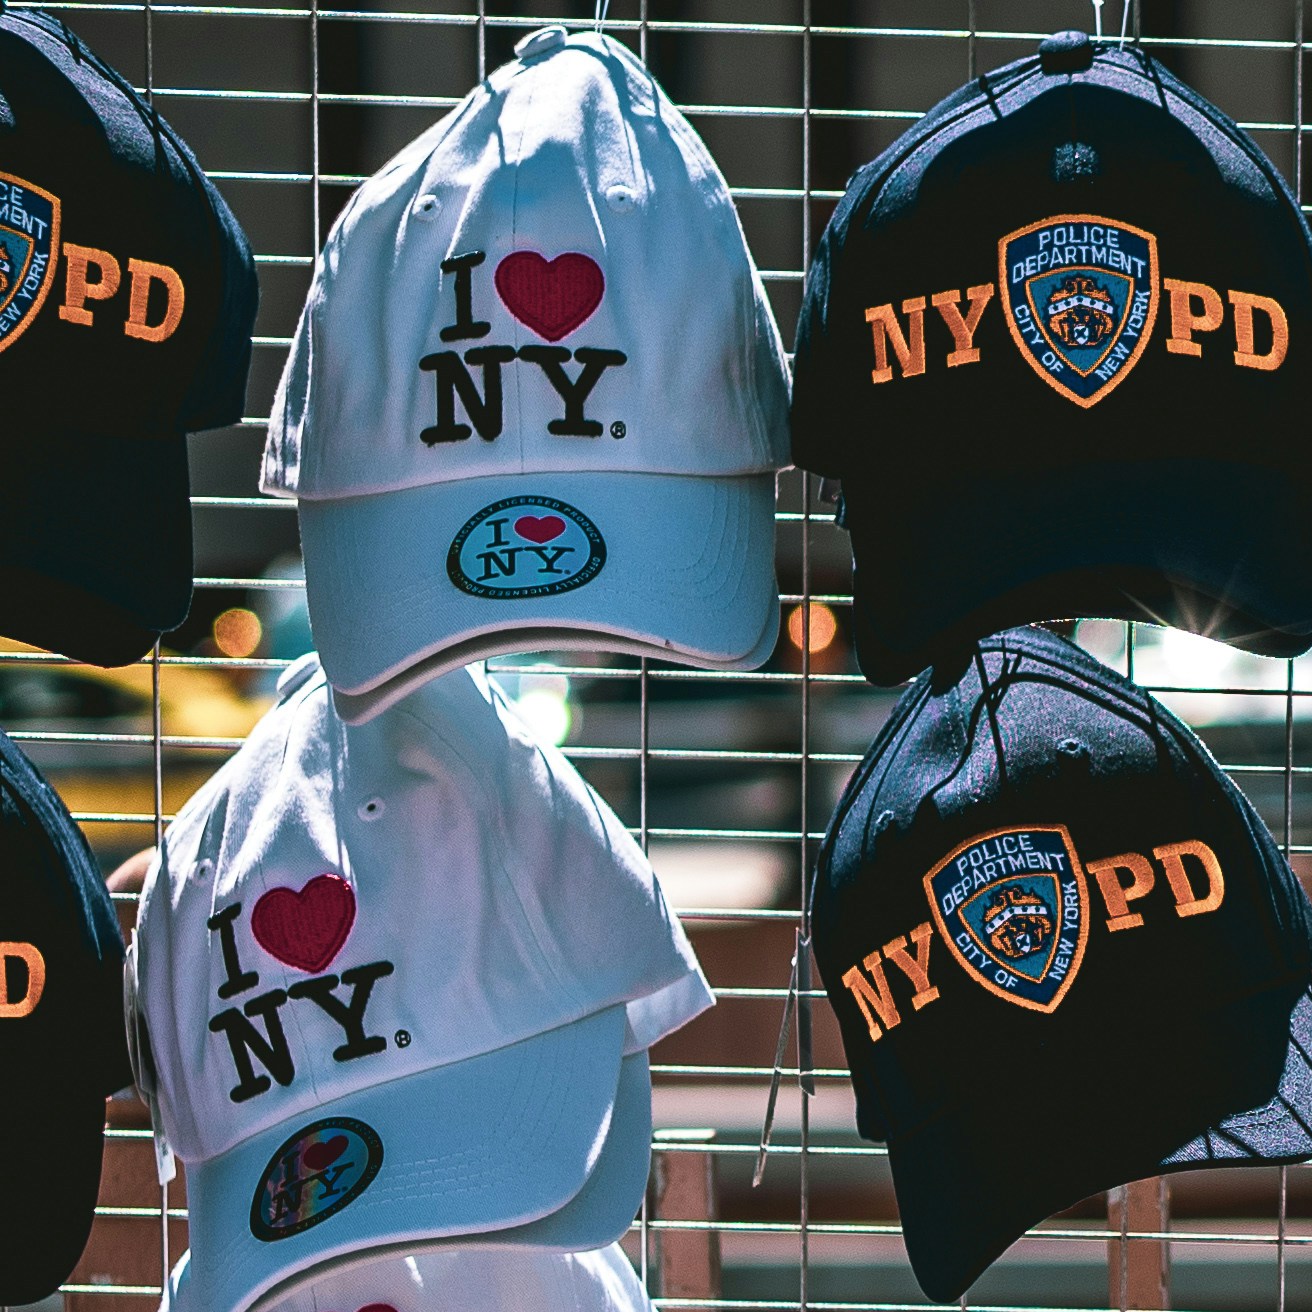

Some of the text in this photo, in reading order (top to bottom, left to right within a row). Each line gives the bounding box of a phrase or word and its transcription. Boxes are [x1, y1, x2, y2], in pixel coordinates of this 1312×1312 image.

[1012, 245, 1146, 284] DEPARTMENT
[1038, 225, 1120, 251] POLICE
[16, 251, 49, 300] YORK
[59, 242, 185, 342] PD
[440, 250, 491, 342] I
[864, 283, 995, 384] NY
[1163, 277, 1290, 371] PD
[1014, 304, 1064, 373] CITY OF
[1094, 290, 1151, 381] NEW YORK
[485, 517, 510, 548] I
[942, 852, 1065, 916] DEPARTMENT
[956, 834, 1034, 877] POLICE
[207, 902, 259, 999] I
[841, 839, 1225, 1042] NY PD
[955, 932, 1019, 988] CITY OF
[1049, 880, 1079, 981] NEW YORK
[280, 1150, 301, 1189] I
